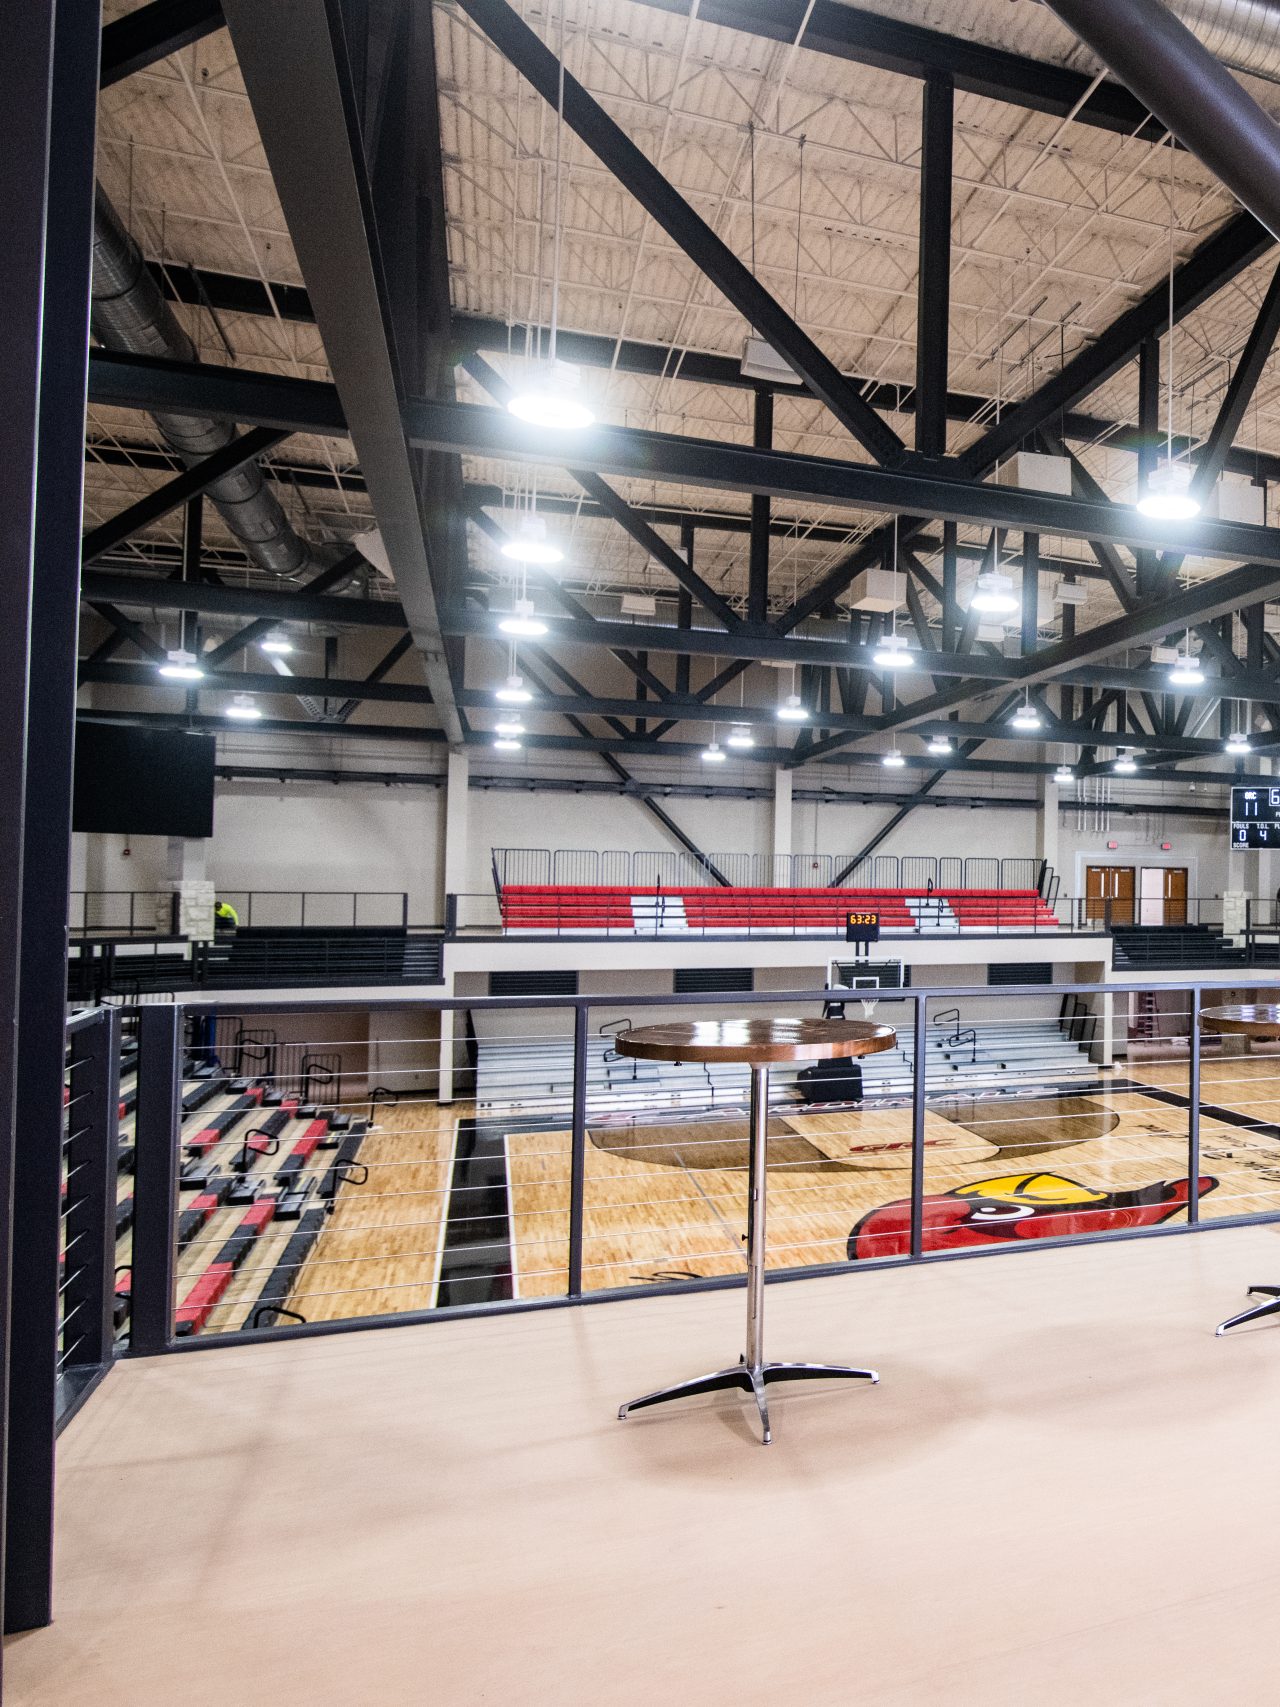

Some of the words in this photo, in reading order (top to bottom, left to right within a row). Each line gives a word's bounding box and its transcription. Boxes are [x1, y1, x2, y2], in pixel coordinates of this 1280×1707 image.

[1239, 830, 1247, 842] 0
[1259, 830, 1267, 841] 4
[850, 915, 876, 924] 63:23
